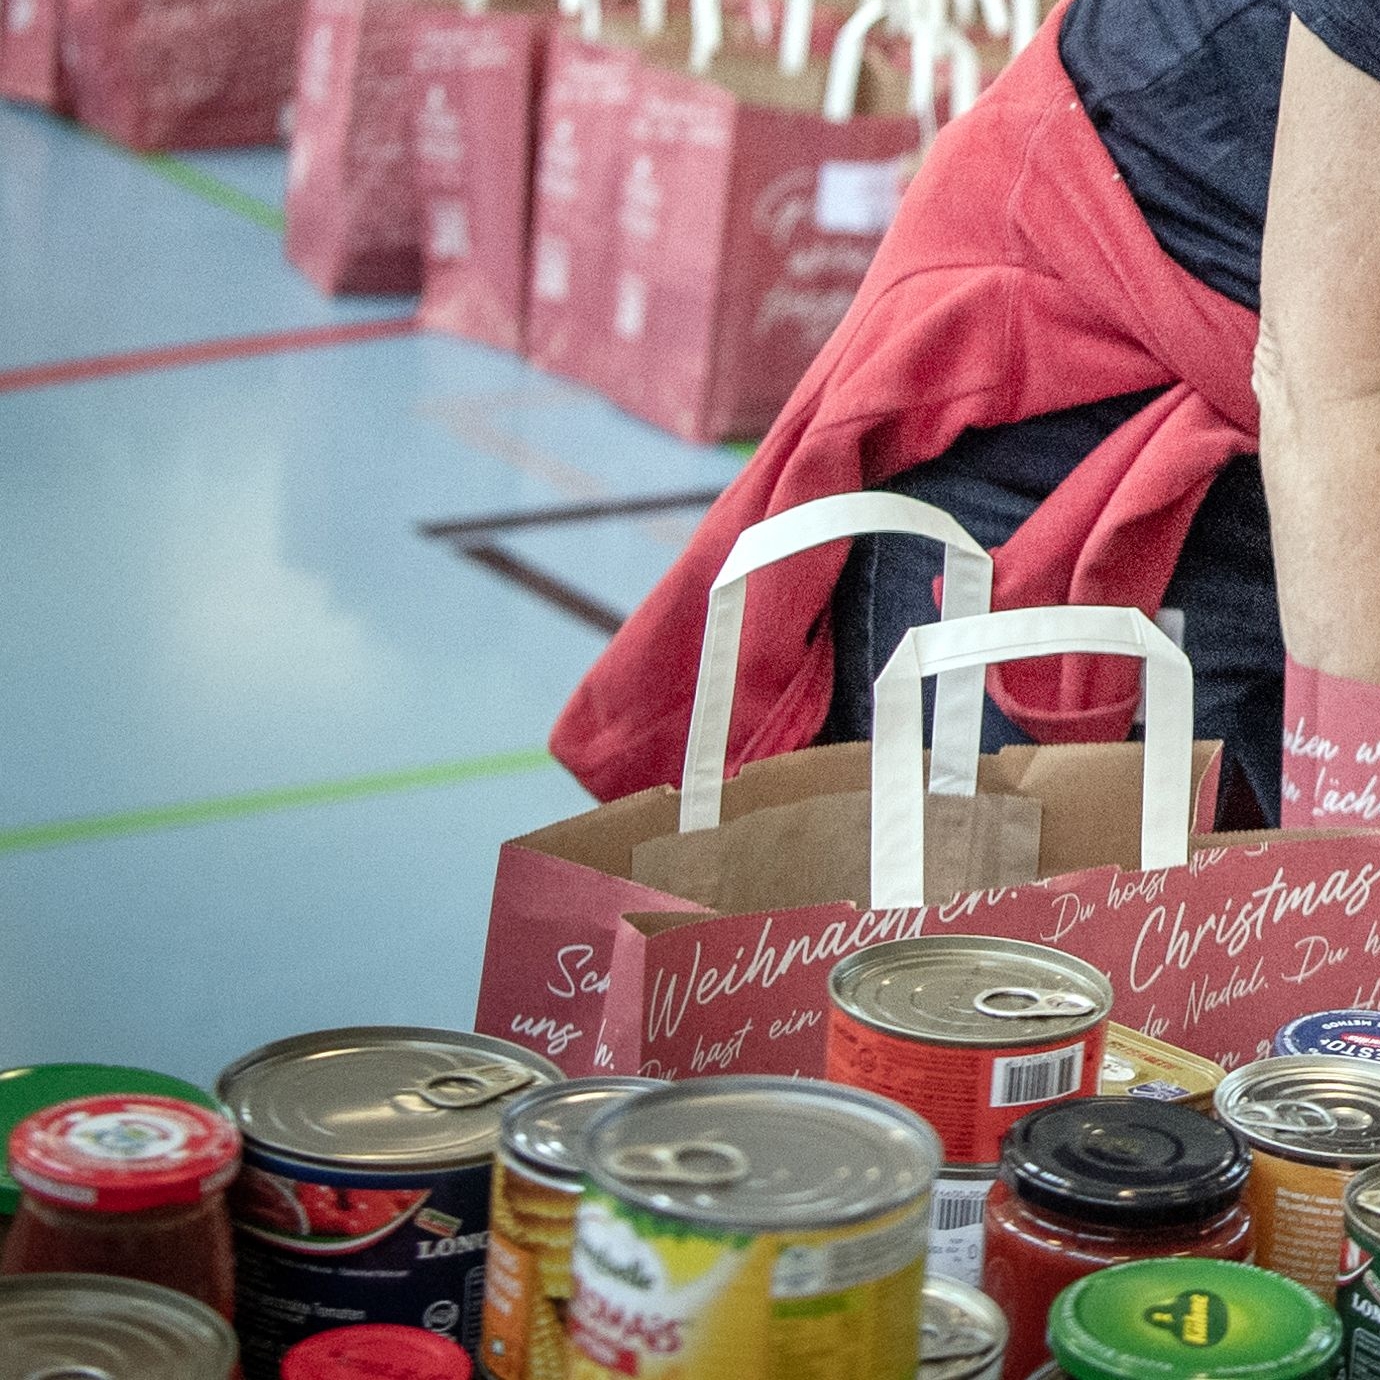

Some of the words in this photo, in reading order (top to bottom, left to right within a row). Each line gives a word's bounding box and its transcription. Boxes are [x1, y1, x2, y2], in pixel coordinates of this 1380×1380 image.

[1040, 892, 1096, 942] Du
[1282, 935, 1350, 984] Du
[511, 1013, 583, 1055] uns
[691, 1019, 755, 1072] hast
[769, 1010, 823, 1041] ein
[1321, 1019, 1373, 1030] METHOD
